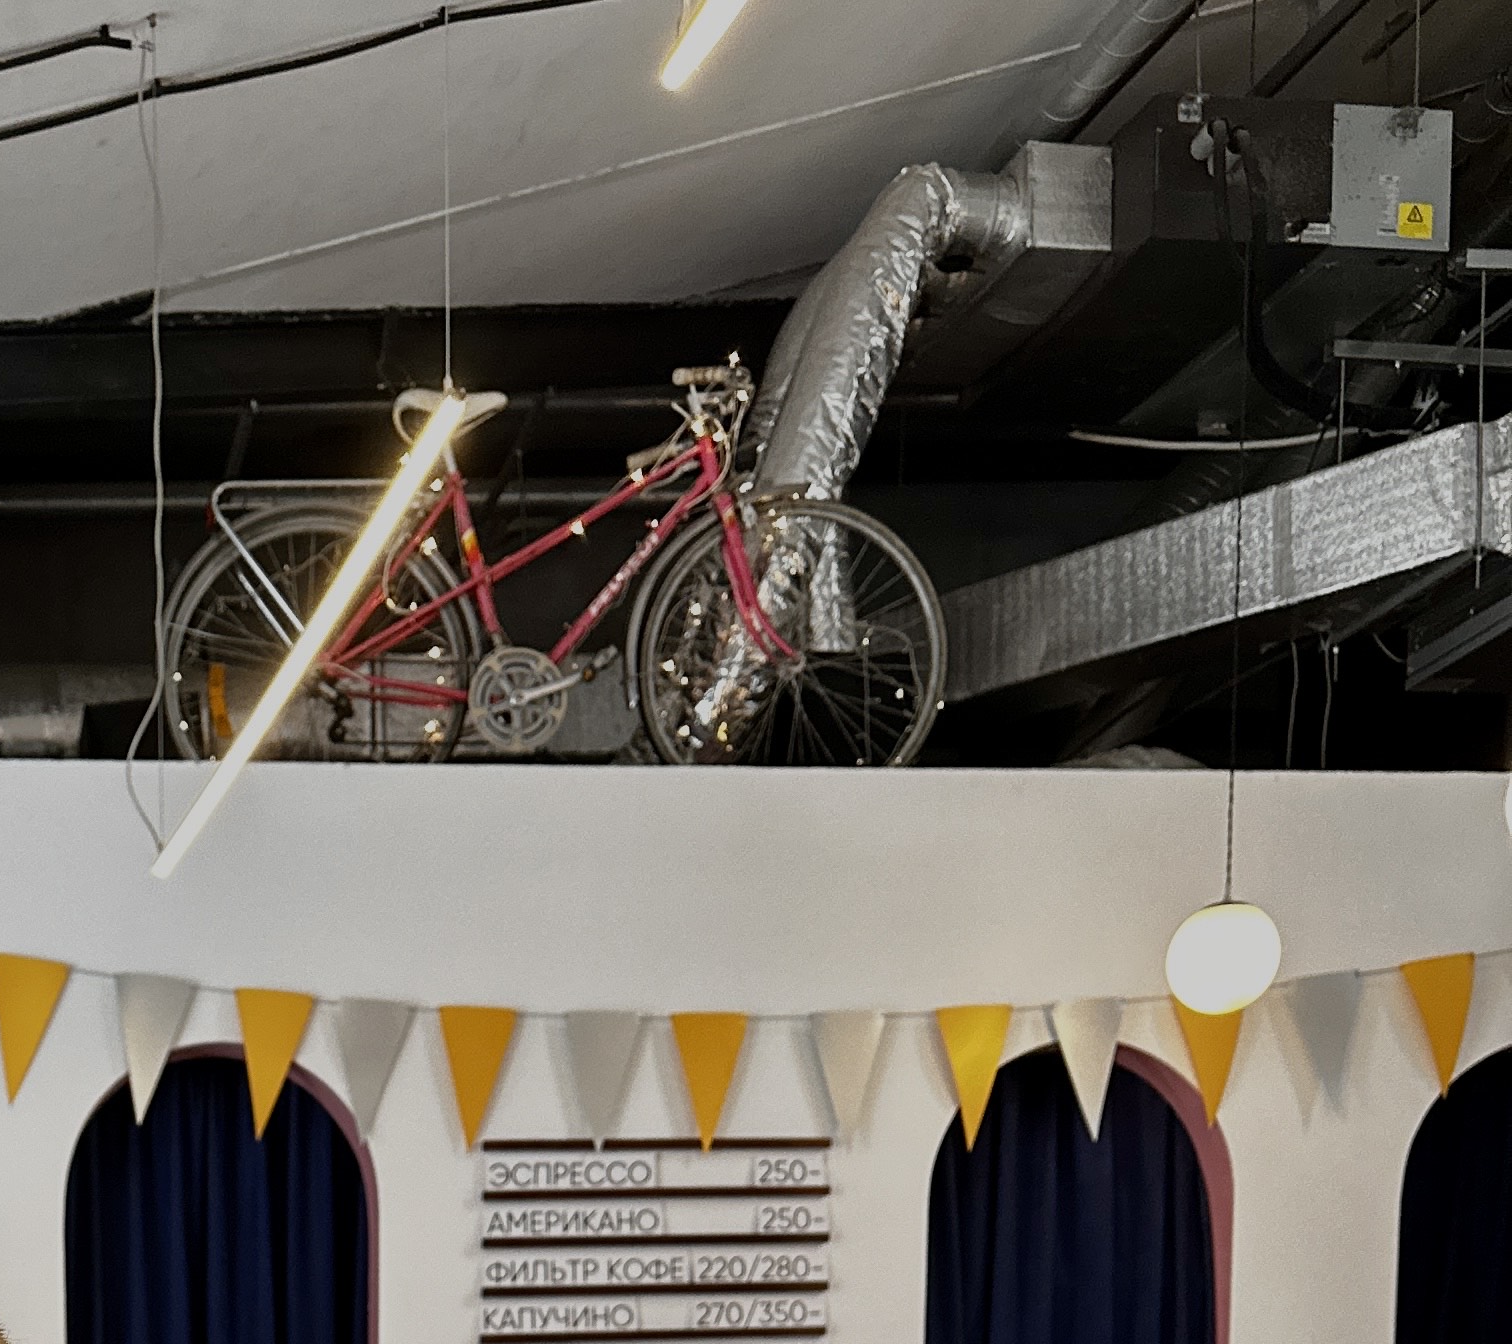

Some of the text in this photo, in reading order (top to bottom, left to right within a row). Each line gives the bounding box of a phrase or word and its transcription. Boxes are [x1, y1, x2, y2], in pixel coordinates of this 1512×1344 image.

[489, 1160, 653, 1187] ЭСПРЕССО
[487, 1207, 660, 1234] АМЕРИКАНО
[486, 1258, 599, 1283] ФИЛЬТР
[607, 1256, 683, 1281] КОФЕ
[483, 1303, 635, 1330] КАПУЧИНО
